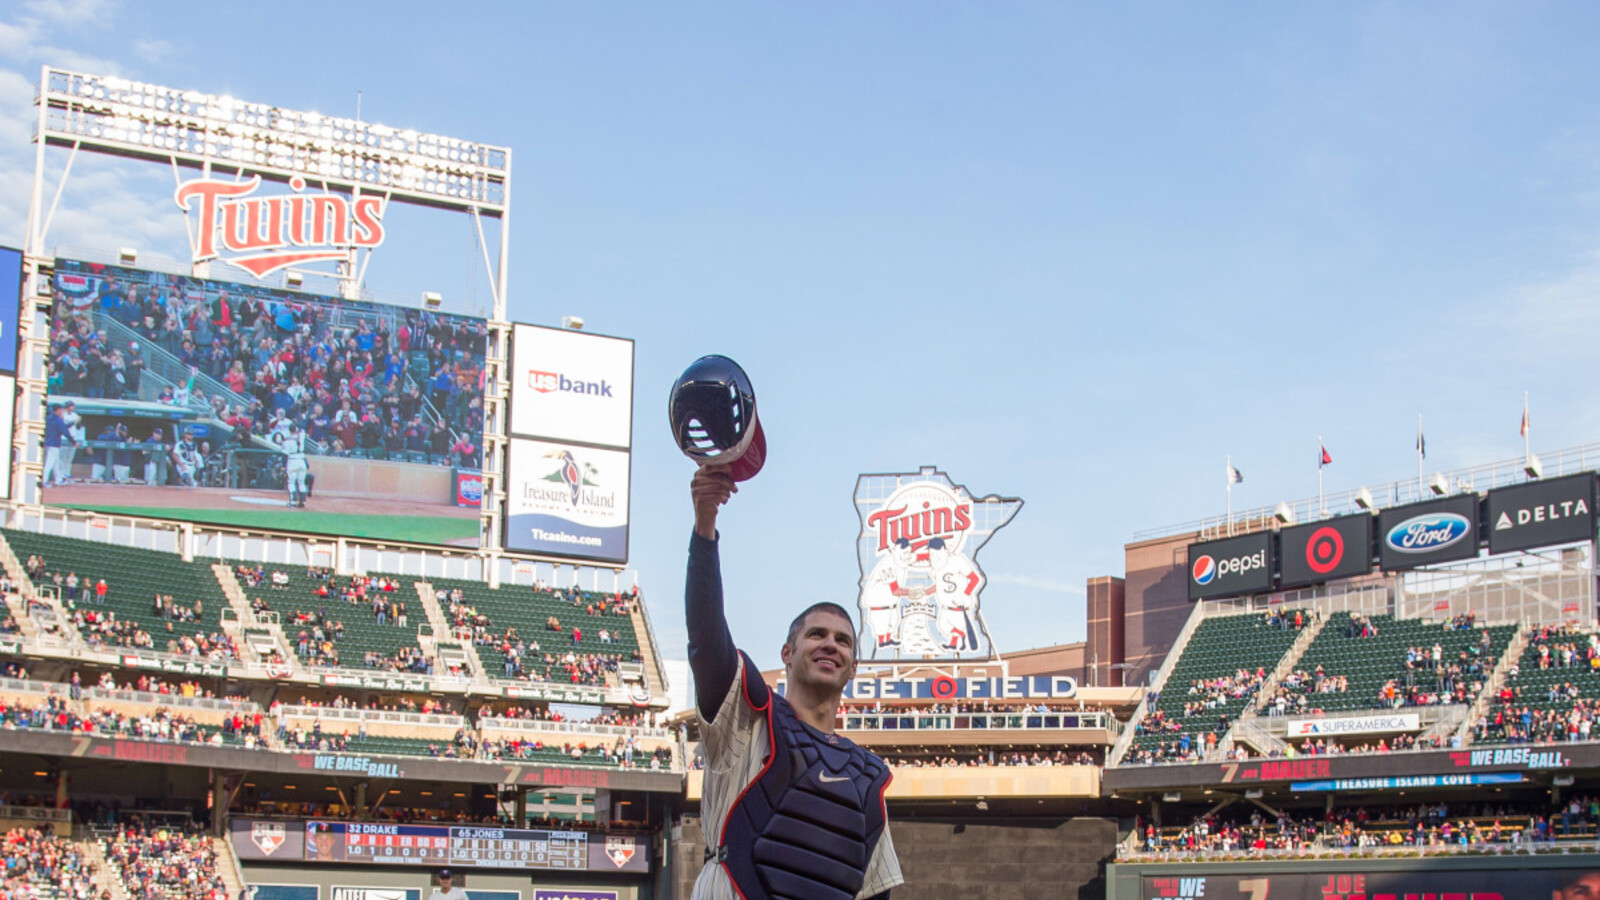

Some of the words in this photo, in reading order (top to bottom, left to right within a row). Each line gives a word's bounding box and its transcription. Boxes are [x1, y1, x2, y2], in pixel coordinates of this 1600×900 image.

[175, 174, 385, 262] Twins
[524, 482, 569, 503] Treasure
[582, 489, 614, 508] Island
[1518, 499, 1588, 525] DELTA
[868, 501, 971, 552] Twins
[1402, 520, 1452, 547] Ford
[1217, 549, 1266, 579] pepsi
[966, 676, 1077, 698] FIELD
[1322, 718, 1406, 732] SUPERAMERICA
[71, 736, 92, 757] 7
[114, 741, 187, 763] MAUER
[1471, 750, 1493, 766] WE
[314, 755, 335, 770] WE
[1221, 763, 1239, 783] 7
[1261, 759, 1331, 780] MAUER
[503, 766, 522, 784] 7
[542, 768, 609, 787] MAUER
[1335, 777, 1390, 790] TREASURE
[1395, 775, 1436, 787] ISLAND
[1443, 774, 1472, 786] COVE
[348, 824, 362, 833] 32
[362, 825, 399, 835] DRAKE
[458, 829, 471, 838] 65
[472, 830, 504, 839] JONES
[1180, 878, 1206, 897] WE
[1321, 875, 1366, 894] JOE
